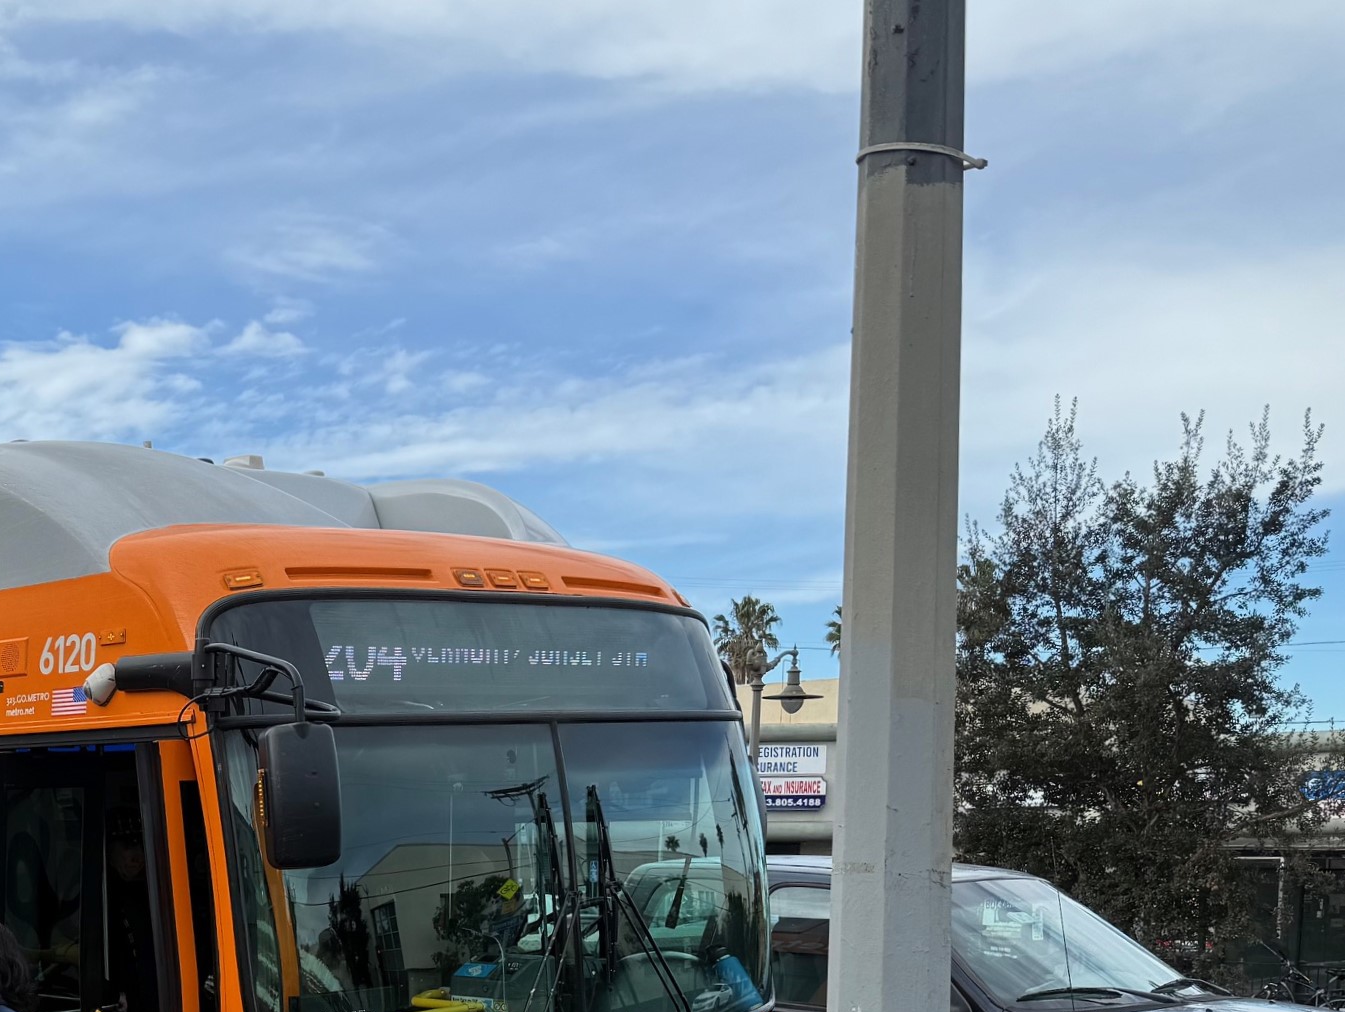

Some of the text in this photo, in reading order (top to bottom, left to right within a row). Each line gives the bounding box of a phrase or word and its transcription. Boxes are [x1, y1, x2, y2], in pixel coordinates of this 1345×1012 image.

[39, 632, 97, 675] 6120
[6, 692, 50, 706] 323.GO.METRO
[6, 707, 35, 717] metro.net
[758, 746, 819, 758] EGISTRATION
[783, 781, 821, 794] INSURANCE
[766, 798, 821, 806] 3.805.4188
